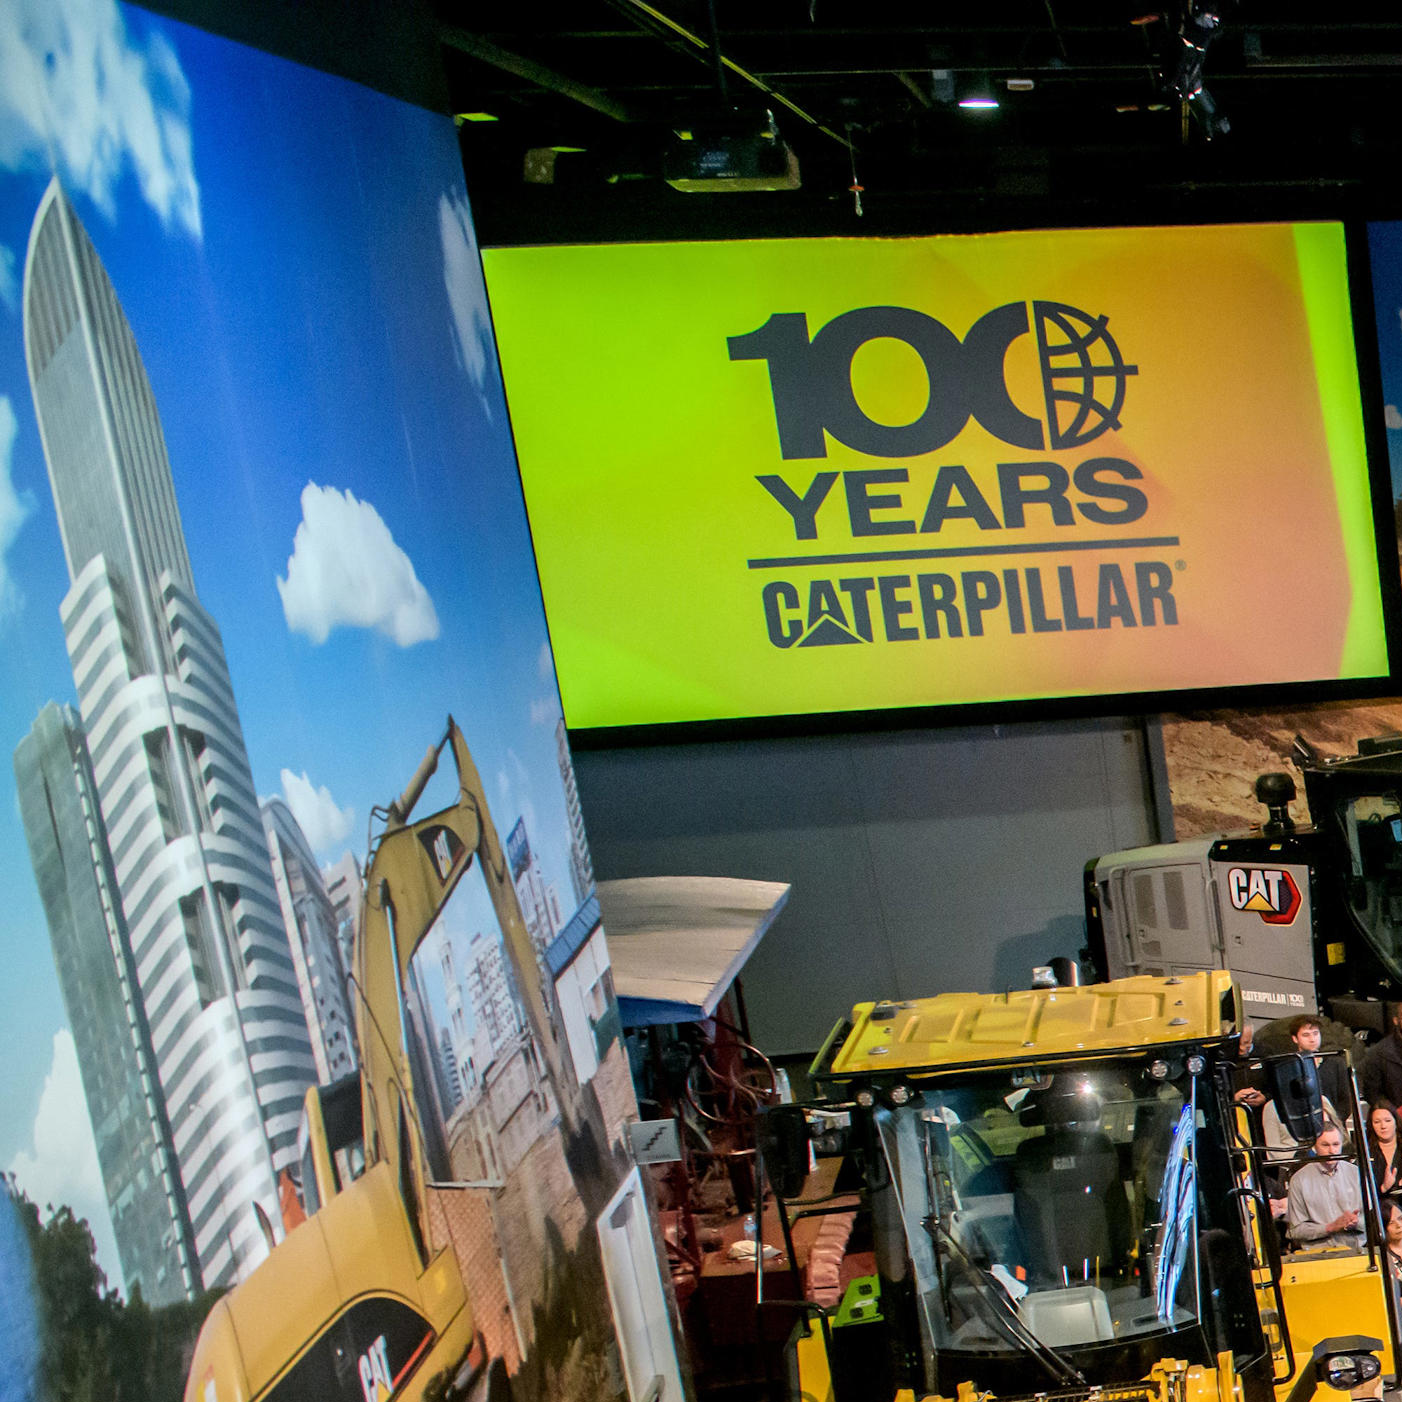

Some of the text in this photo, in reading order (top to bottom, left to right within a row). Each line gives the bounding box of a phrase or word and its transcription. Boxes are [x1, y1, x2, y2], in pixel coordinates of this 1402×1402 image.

[727, 300, 1138, 460] 100
[755, 458, 1148, 540] YEARS
[434, 830, 454, 880] CAT
[1229, 869, 1282, 912] CAT
[1241, 990, 1286, 1005] CATERPILLAR
